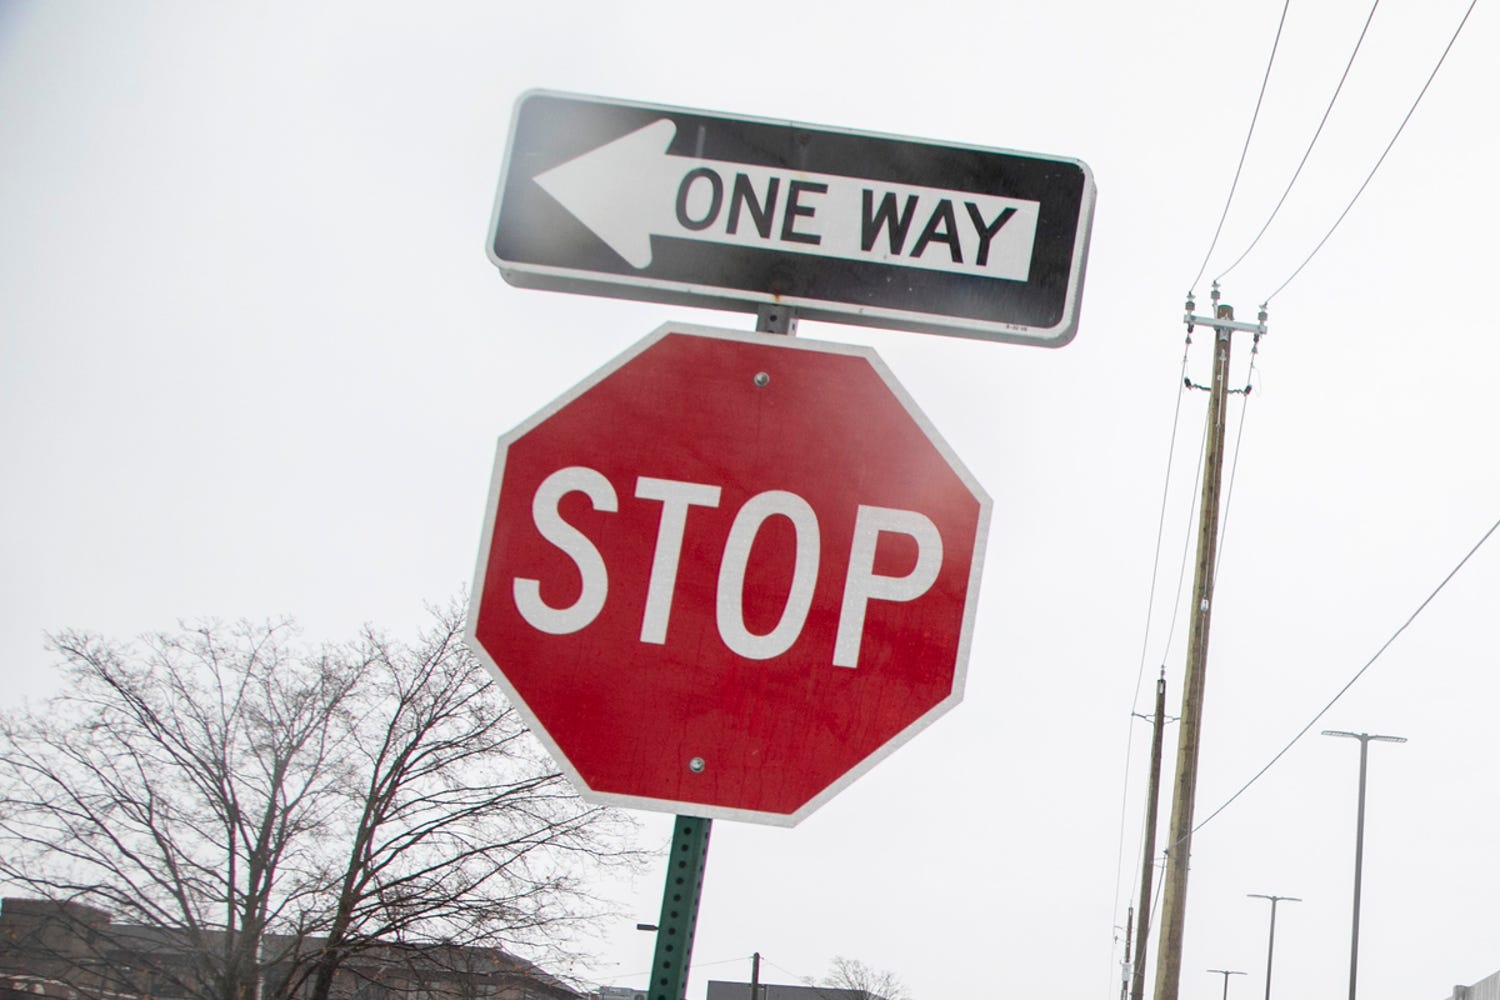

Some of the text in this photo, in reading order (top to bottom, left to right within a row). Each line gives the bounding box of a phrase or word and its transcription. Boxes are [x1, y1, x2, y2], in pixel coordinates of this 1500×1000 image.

[674, 167, 1017, 267] ONE WAY
[512, 465, 944, 670] STOP
